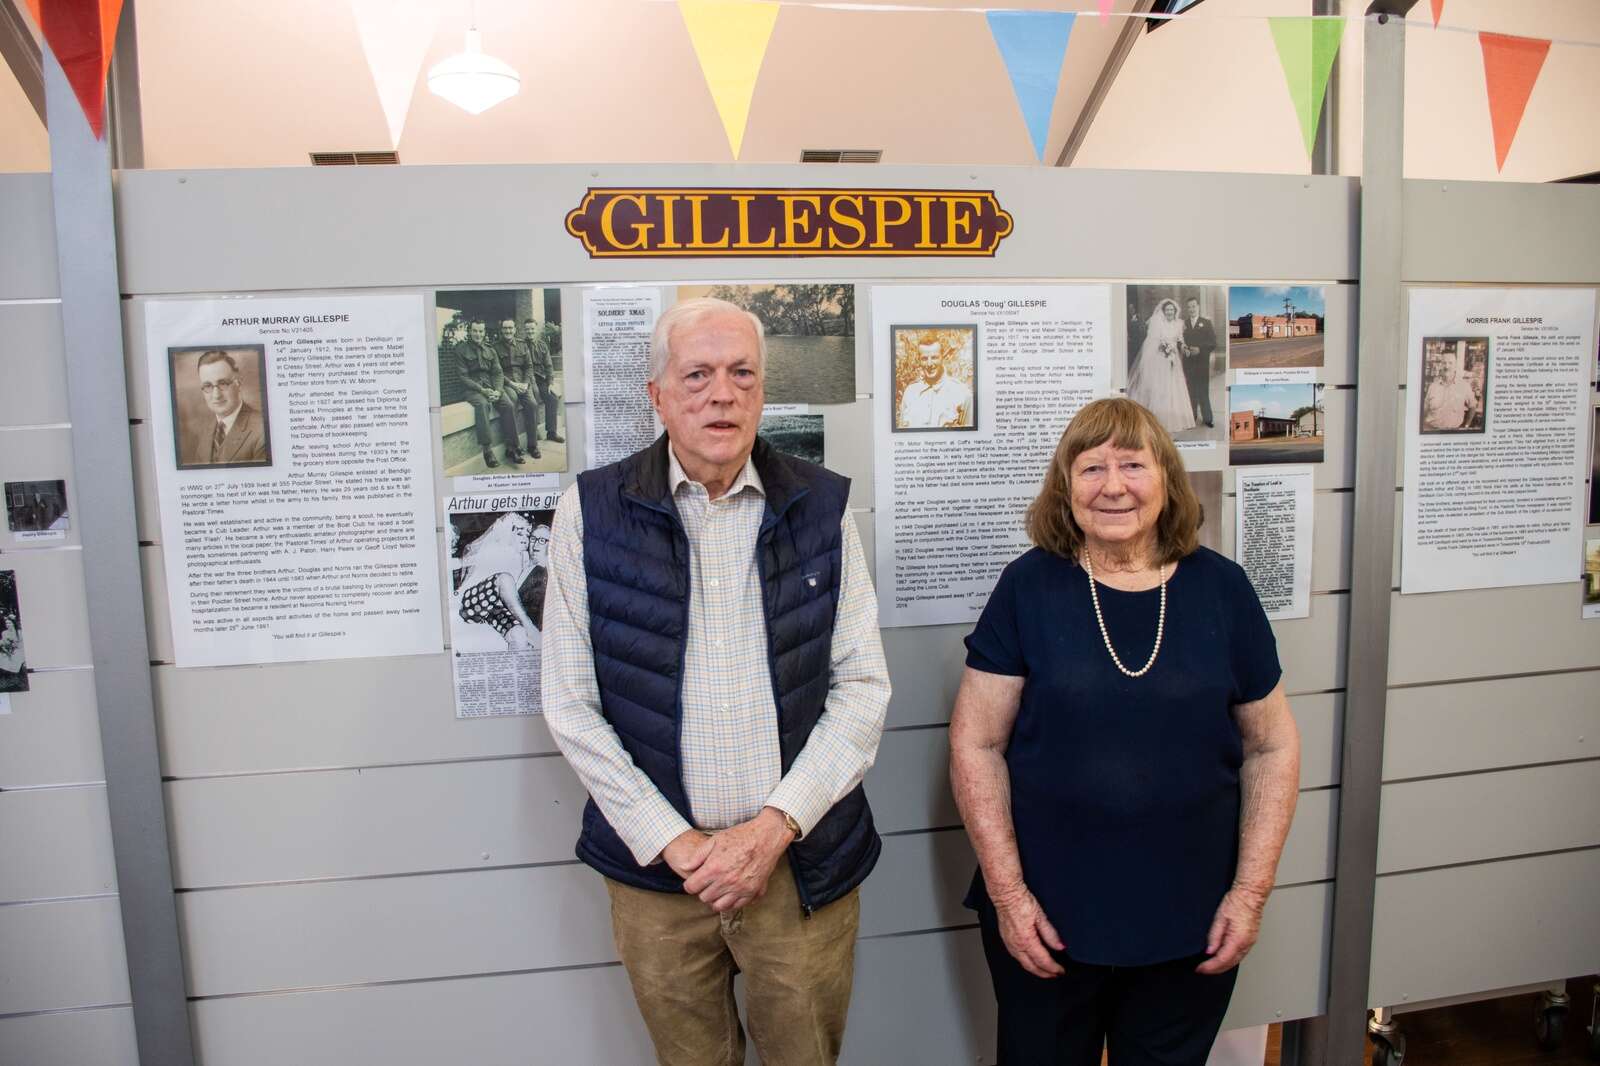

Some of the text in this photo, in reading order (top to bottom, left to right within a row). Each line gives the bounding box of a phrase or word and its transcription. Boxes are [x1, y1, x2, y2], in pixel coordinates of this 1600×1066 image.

[601, 194, 983, 250] GILLESPIE
[222, 314, 350, 326] ARTHUR MURRAY GILLESPIE
[448, 492, 564, 511] Arthur gets the gir
